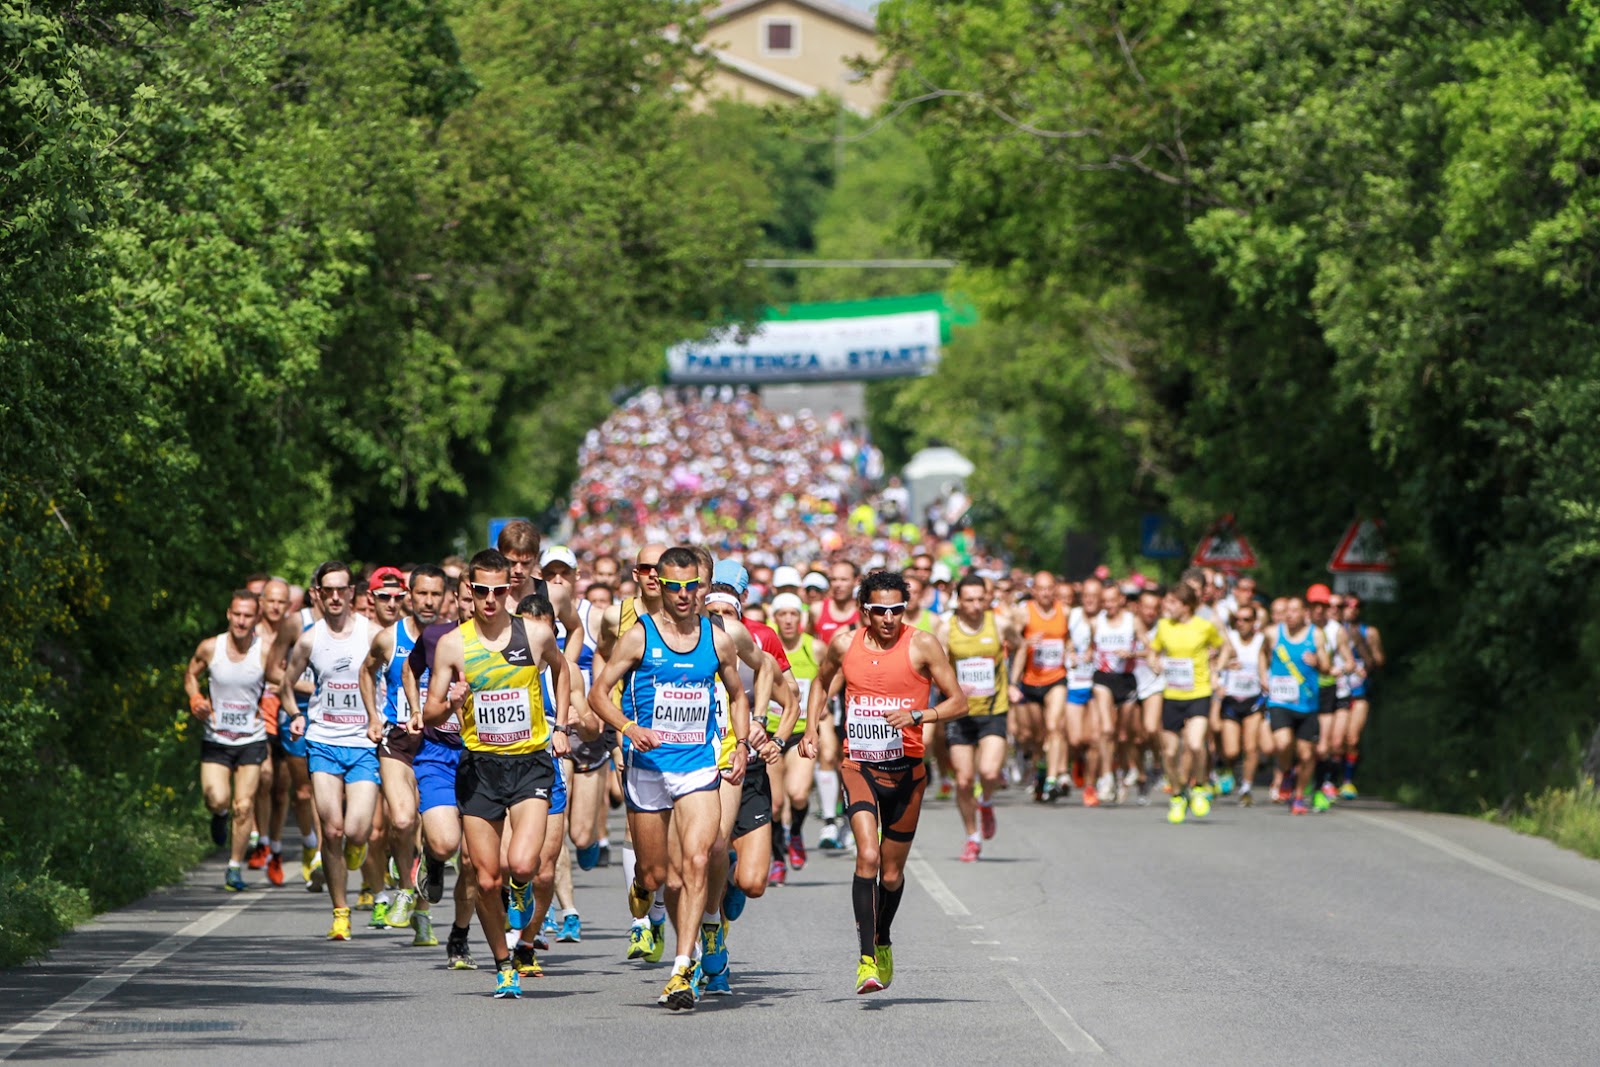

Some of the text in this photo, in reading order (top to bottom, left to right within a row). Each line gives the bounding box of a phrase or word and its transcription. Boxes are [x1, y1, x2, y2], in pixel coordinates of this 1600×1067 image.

[686, 345, 928, 370] PARTENZA START
[343, 694, 357, 708] 41
[478, 704, 525, 724] H1825
[655, 705, 706, 722] CAIMMI
[854, 708, 884, 717] COO
[488, 730, 529, 742] GENERALI
[663, 732, 704, 743] GENERALI
[848, 723, 899, 740] BOURIFA
[860, 750, 901, 760] GENERALI
